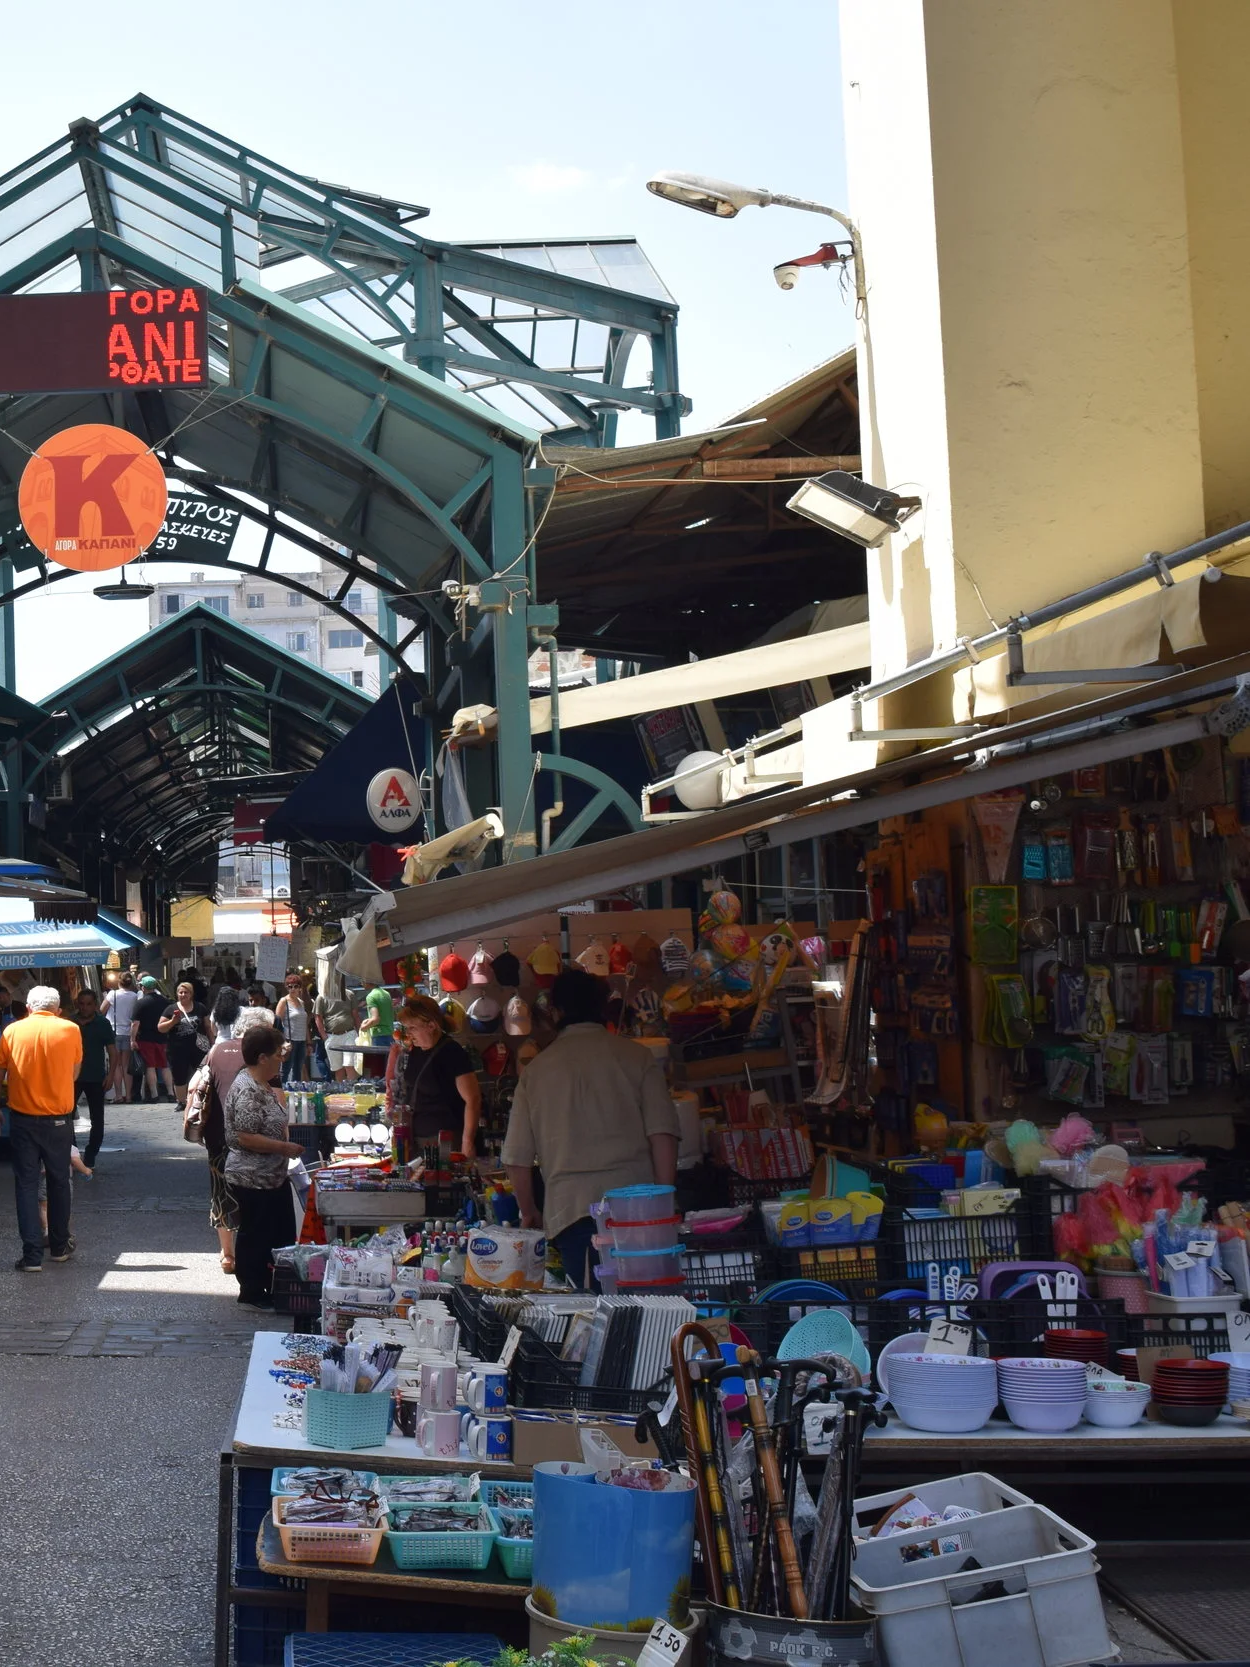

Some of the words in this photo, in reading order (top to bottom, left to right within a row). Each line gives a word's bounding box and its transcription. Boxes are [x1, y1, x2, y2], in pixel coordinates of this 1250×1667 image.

[167, 497, 239, 527] ΠΥΡΟΣ
[158, 520, 231, 545] ΑΣΚΕΥΕΣ
[55, 539, 77, 551] ΑΓΟΡΑ
[78, 538, 136, 550] ΚΑΠΑΝΙ
[380, 808, 412, 818] ΑΛΦΑ
[471, 1240, 496, 1253] Lovely
[932, 1323, 954, 1345] 1
[650, 1623, 680, 1653] 1.50
[769, 1641, 806, 1656] PAOK
[811, 1645, 838, 1658] F.C.
